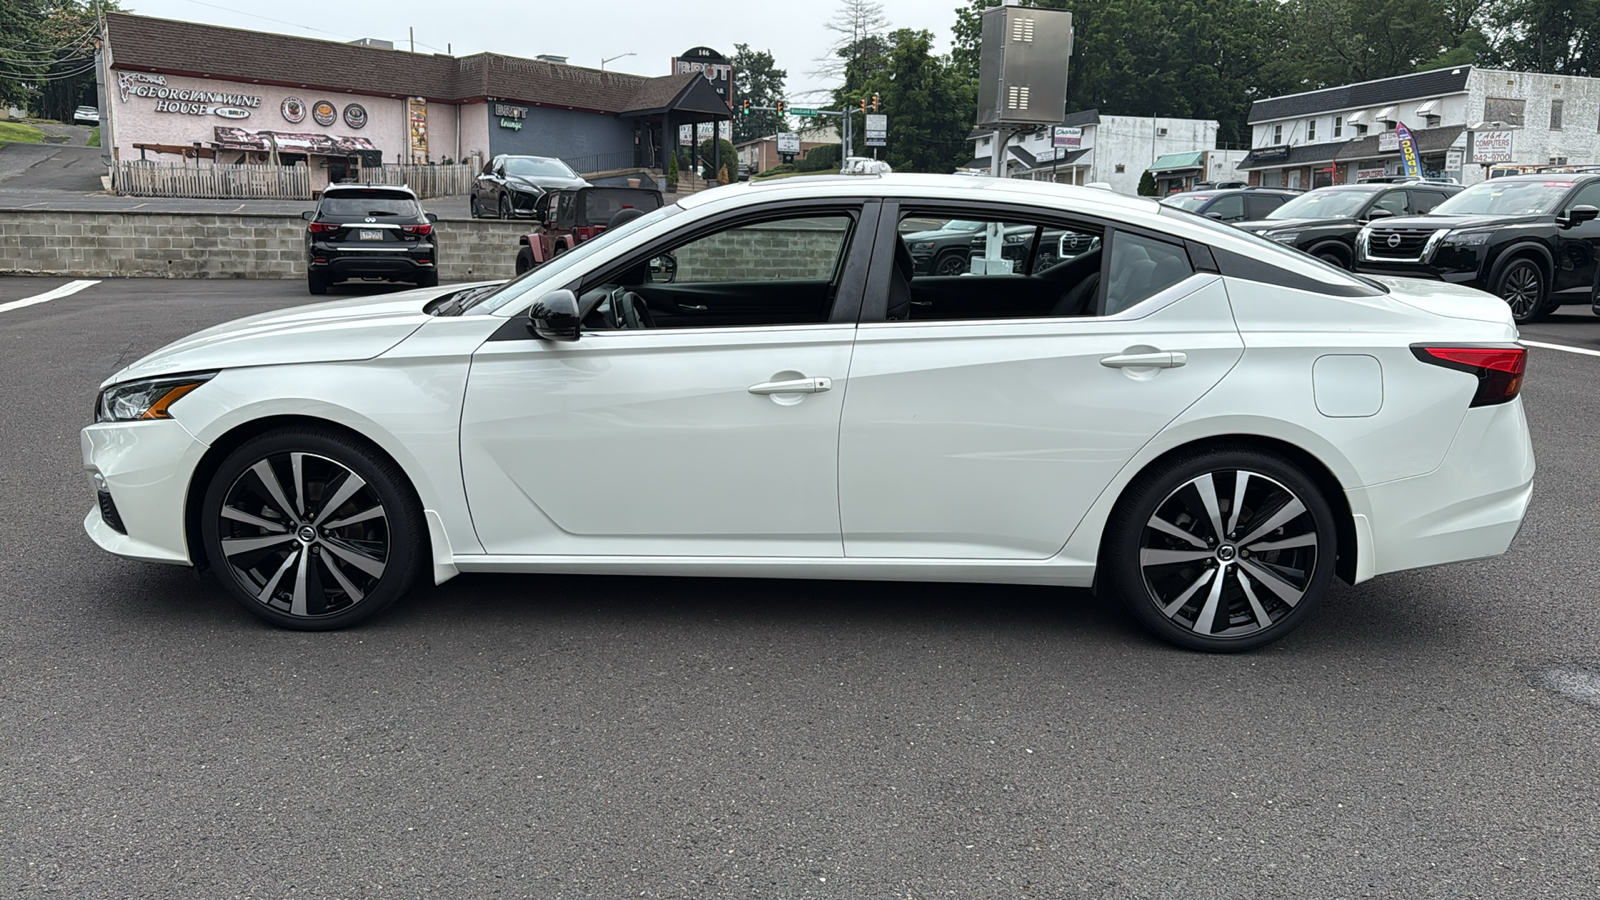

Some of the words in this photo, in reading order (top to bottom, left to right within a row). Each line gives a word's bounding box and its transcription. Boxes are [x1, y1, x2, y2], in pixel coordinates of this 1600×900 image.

[715, 87, 725, 95] AR
[136, 86, 217, 102] GEORGIAN
[221, 93, 262, 108] WINE
[156, 100, 208, 116] HOUSE
[495, 104, 528, 119] BRUT
[228, 109, 246, 117] BRUT
[1475, 139, 1510, 147] COMPUTERS
[1473, 153, 1511, 162] 942-9700
